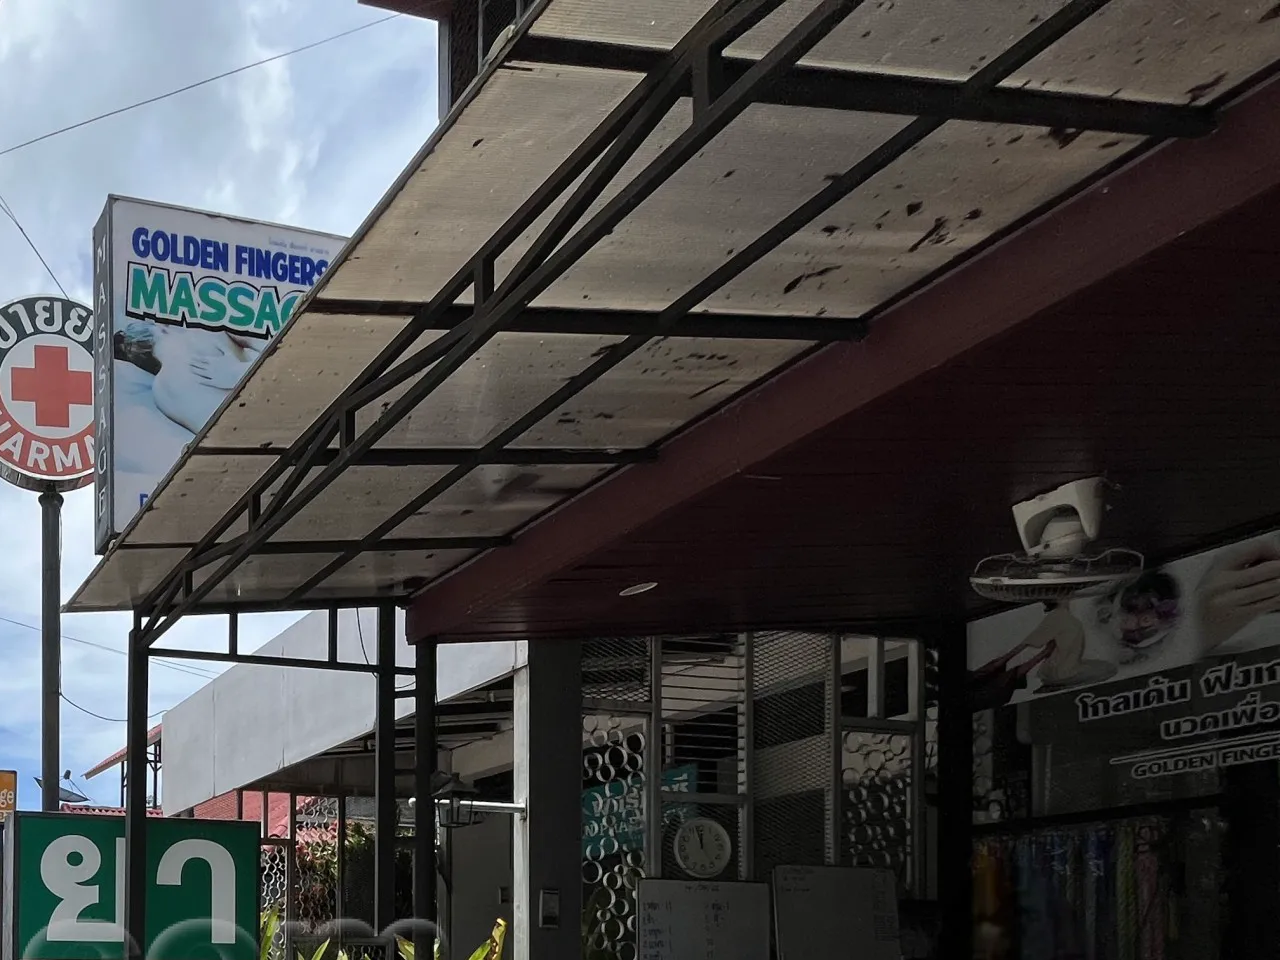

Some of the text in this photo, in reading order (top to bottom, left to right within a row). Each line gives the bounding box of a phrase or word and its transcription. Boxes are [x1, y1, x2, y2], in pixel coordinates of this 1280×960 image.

[131, 227, 229, 273] GOLDEN
[1133, 753, 1215, 777] GOLDEN
[39, 834, 236, 944] ยา
